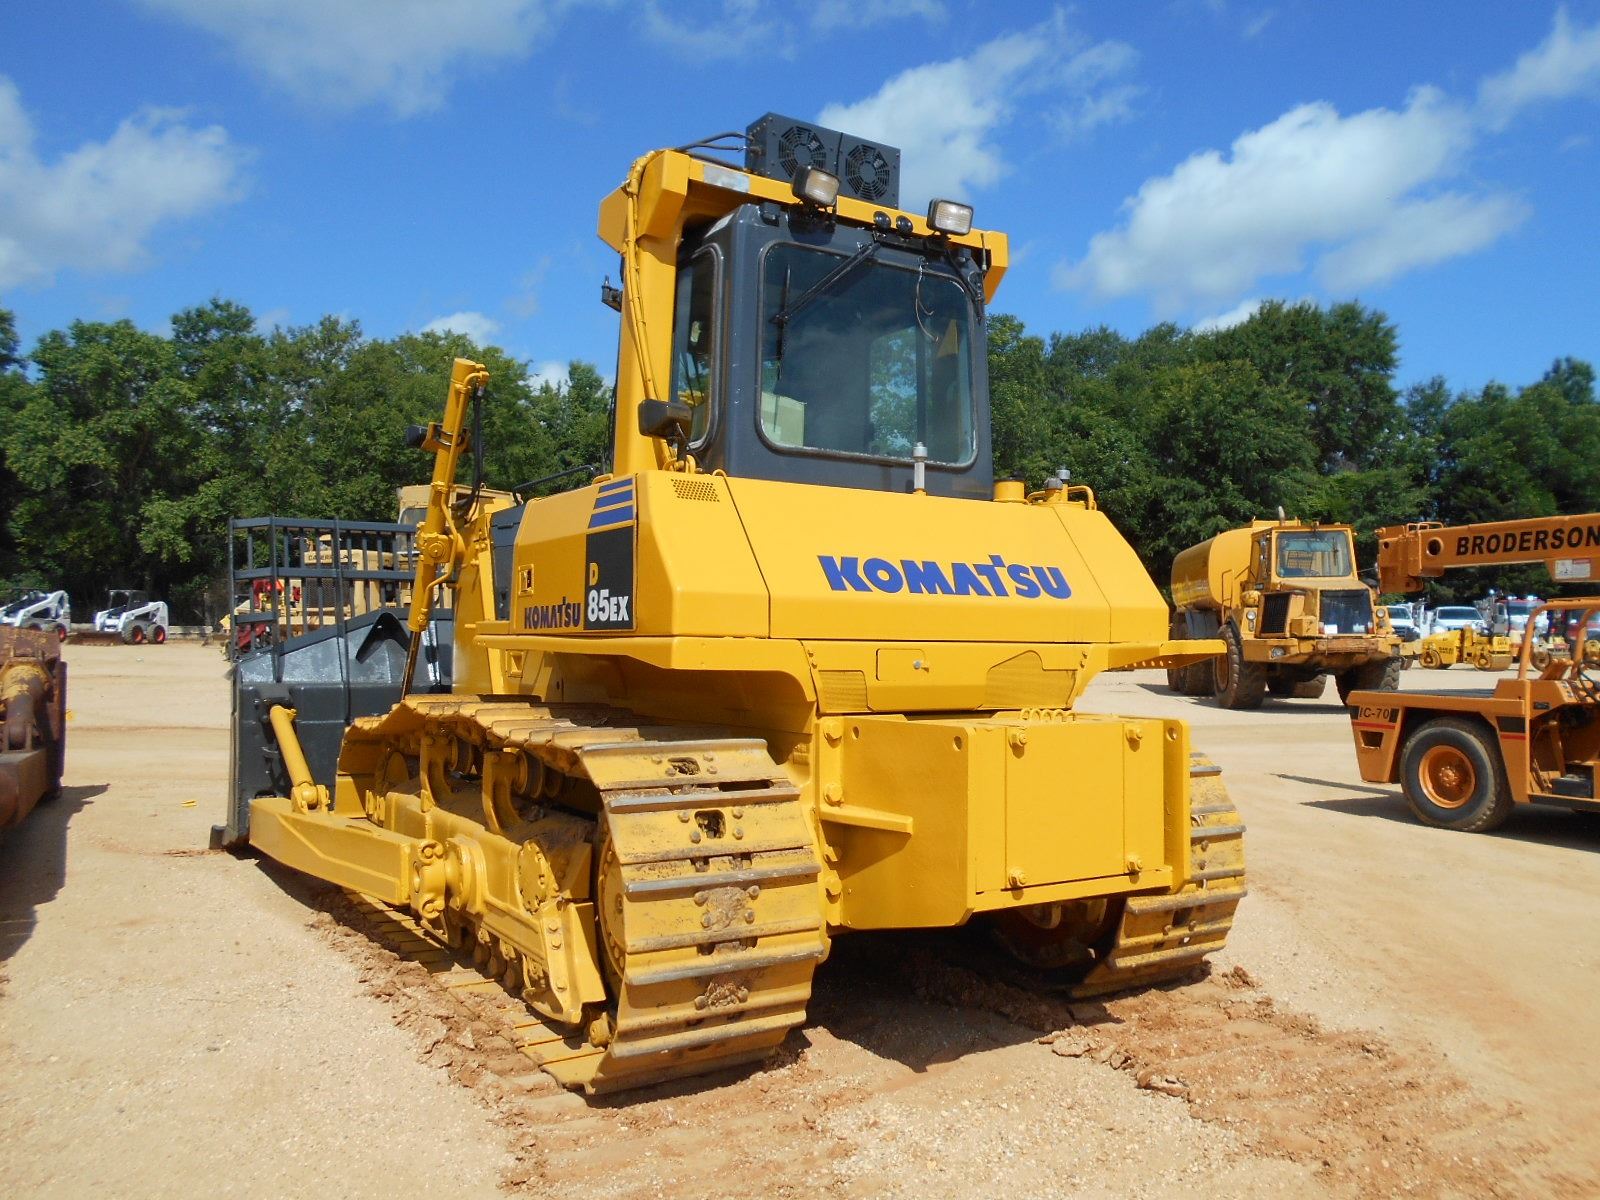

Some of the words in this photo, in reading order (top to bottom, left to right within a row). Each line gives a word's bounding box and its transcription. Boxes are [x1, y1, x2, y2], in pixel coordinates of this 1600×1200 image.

[1456, 526, 1600, 556] BRODERSON
[589, 562, 599, 586] D
[817, 554, 1072, 600] KOMATSU
[524, 596, 581, 630] KOMATSU
[587, 588, 629, 623] 85EX
[1359, 707, 1390, 720] IC-70
